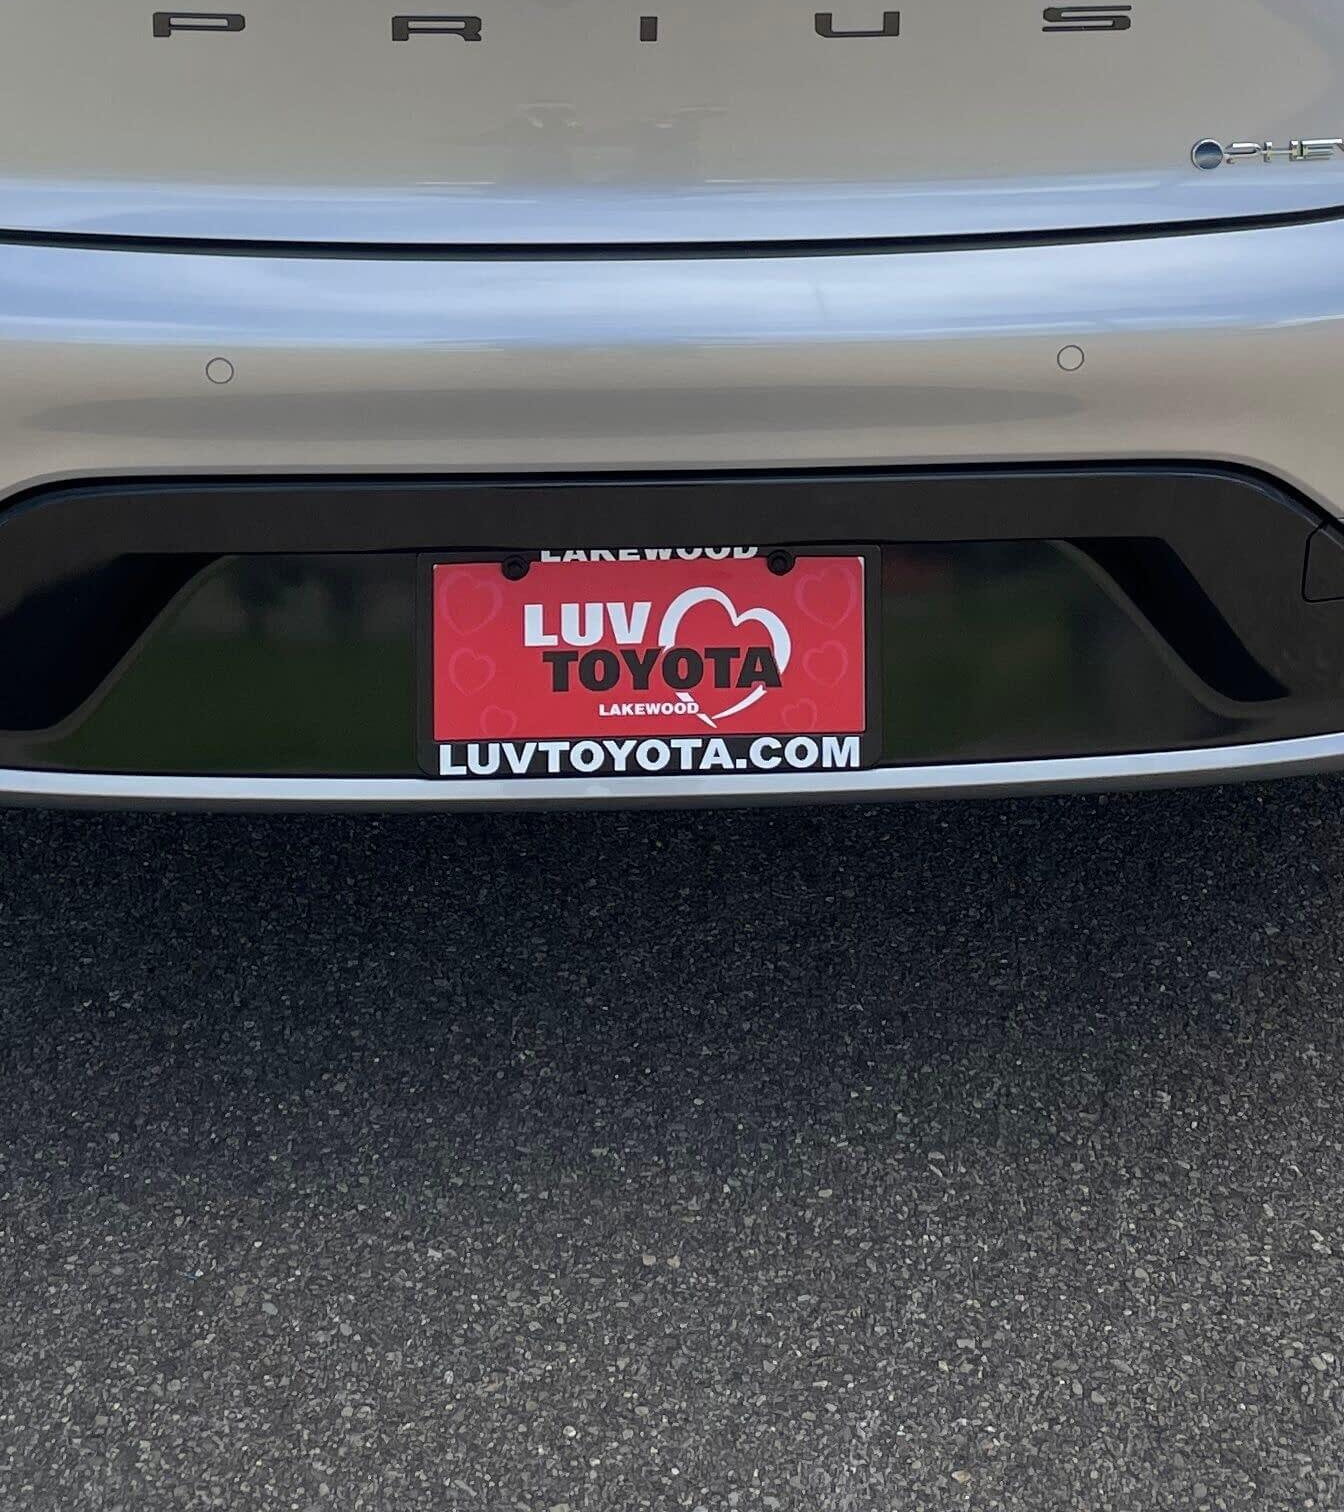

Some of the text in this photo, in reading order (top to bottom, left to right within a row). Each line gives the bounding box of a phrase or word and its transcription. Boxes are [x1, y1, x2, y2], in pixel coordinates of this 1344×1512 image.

[152, 4, 1134, 43] PRIUS
[523, 601, 652, 647] LUV
[542, 646, 782, 693] TOYOTA
[598, 701, 700, 717] LAKEWOOD
[438, 735, 860, 776] LUVTOYOTA.COM
